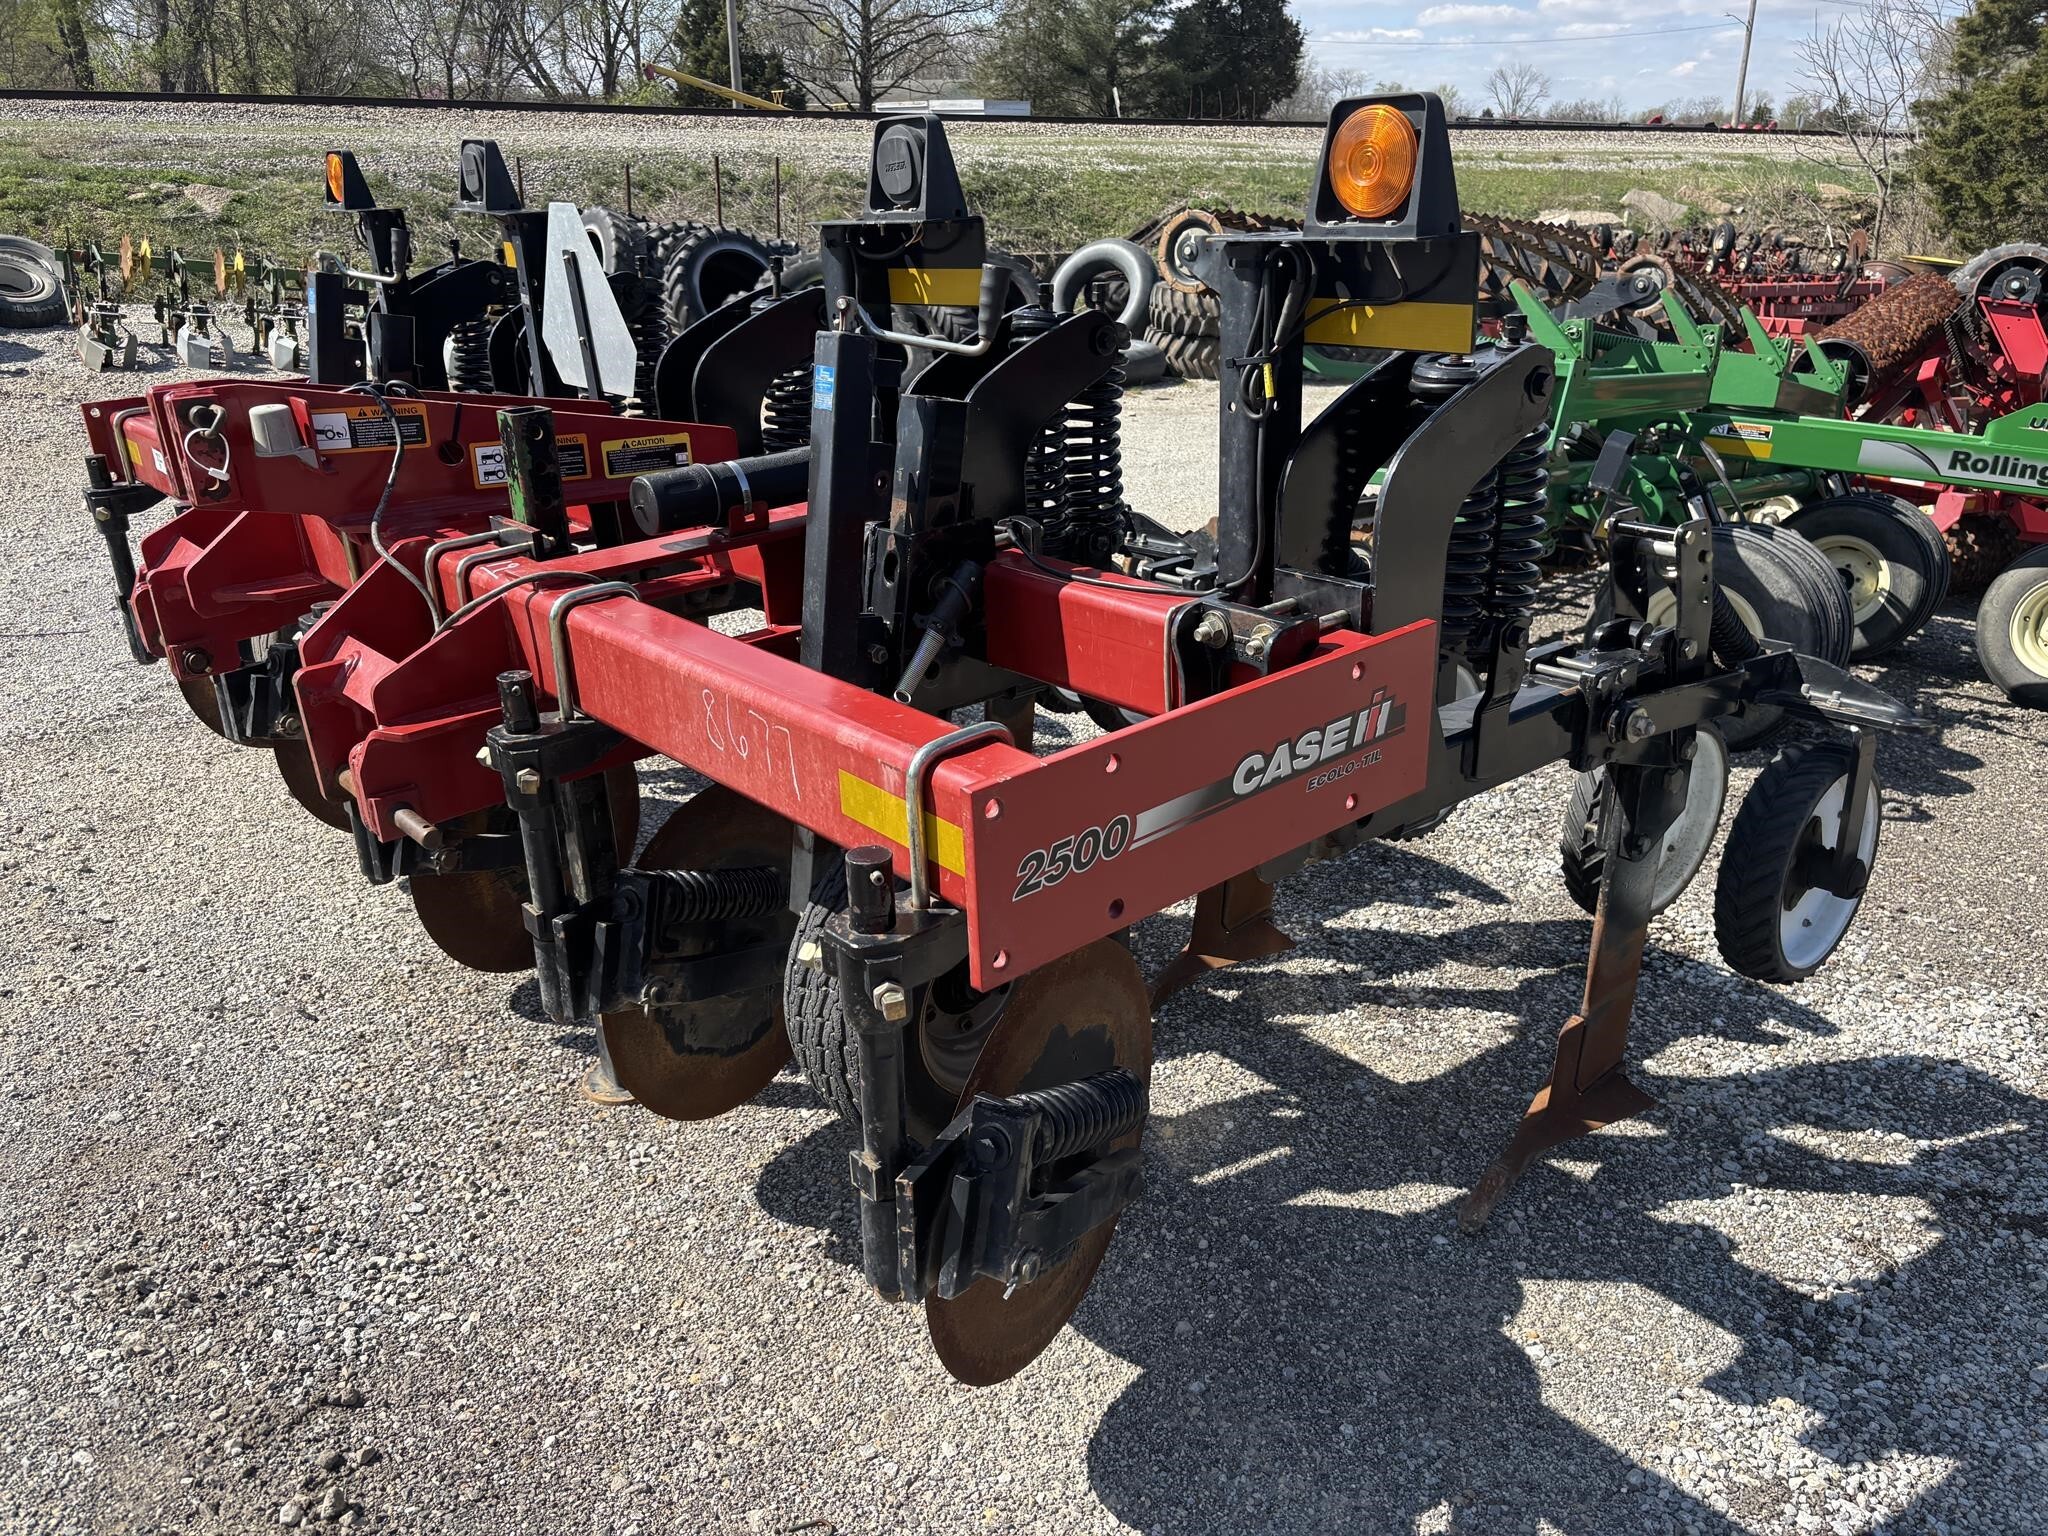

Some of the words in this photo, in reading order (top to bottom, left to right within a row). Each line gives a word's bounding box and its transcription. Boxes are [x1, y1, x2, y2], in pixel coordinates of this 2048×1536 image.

[370, 406, 418, 416] WNING
[556, 436, 579, 444] NING
[631, 437, 665, 447] CAUTION
[1947, 450, 2048, 486] Rolling
[702, 689, 801, 801] 8677
[1232, 716, 1353, 796] CASE
[1012, 814, 1131, 902] 2500
